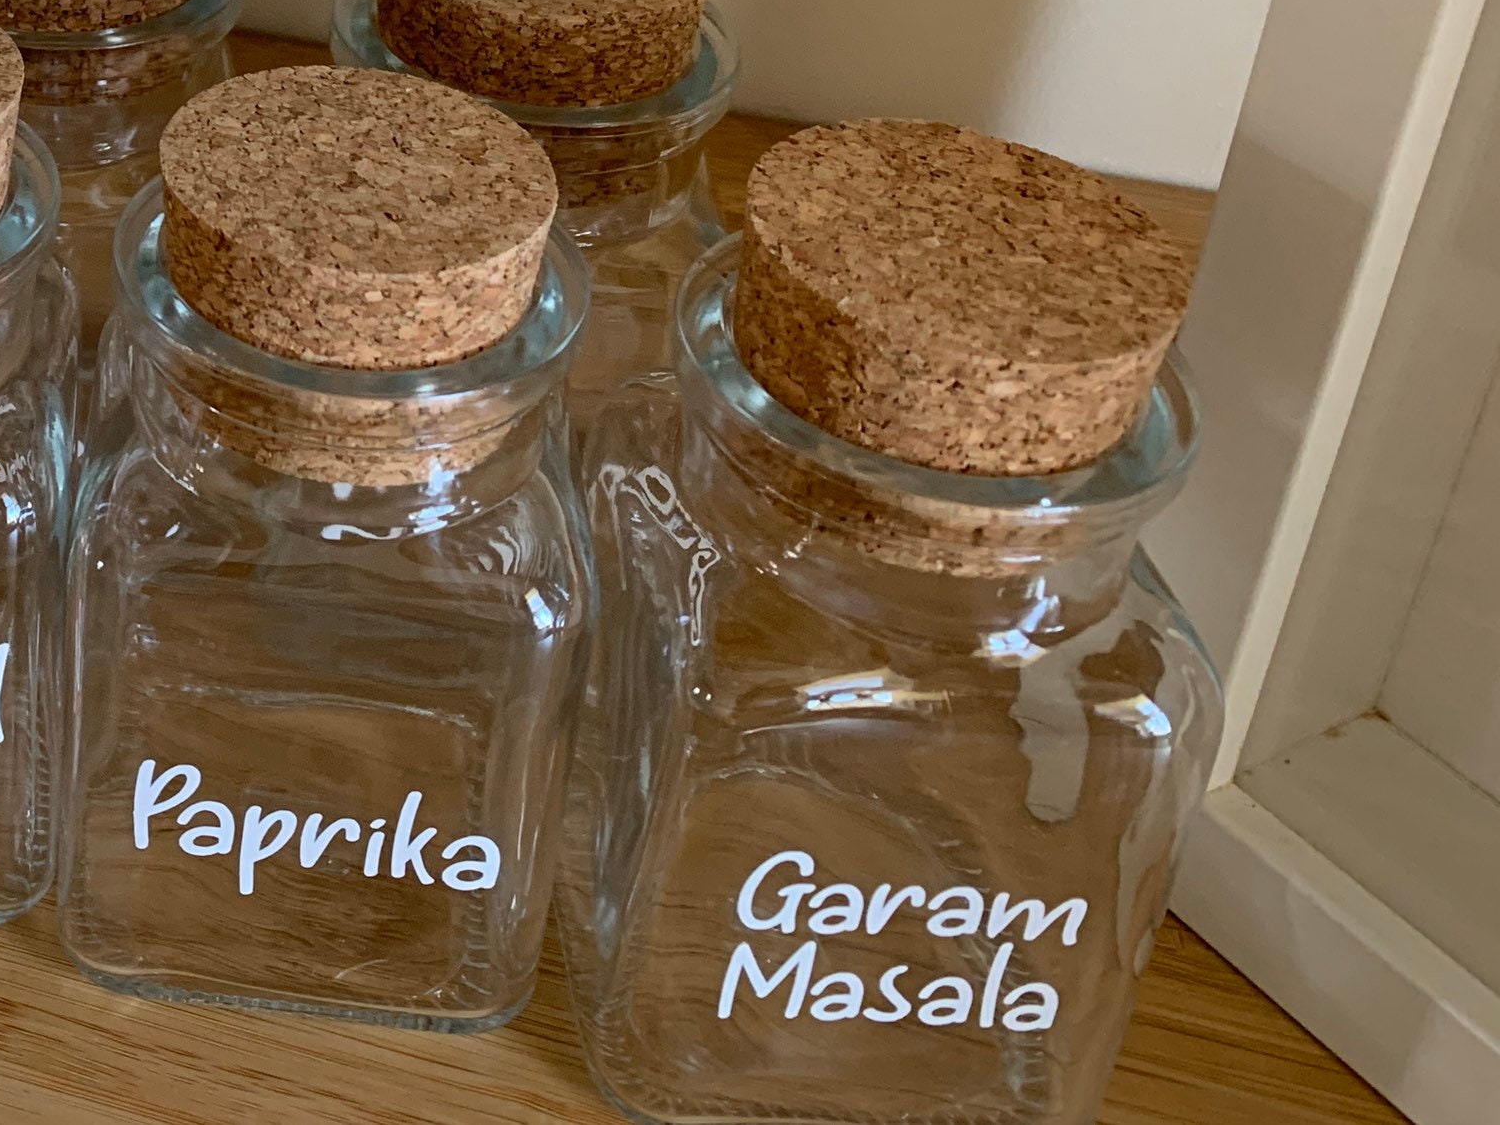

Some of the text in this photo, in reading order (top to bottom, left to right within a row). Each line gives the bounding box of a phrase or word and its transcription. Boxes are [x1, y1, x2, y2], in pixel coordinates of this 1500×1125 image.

[133, 759, 501, 895] Paprika
[737, 850, 1088, 947] Garam
[718, 941, 1059, 1032] Masala
